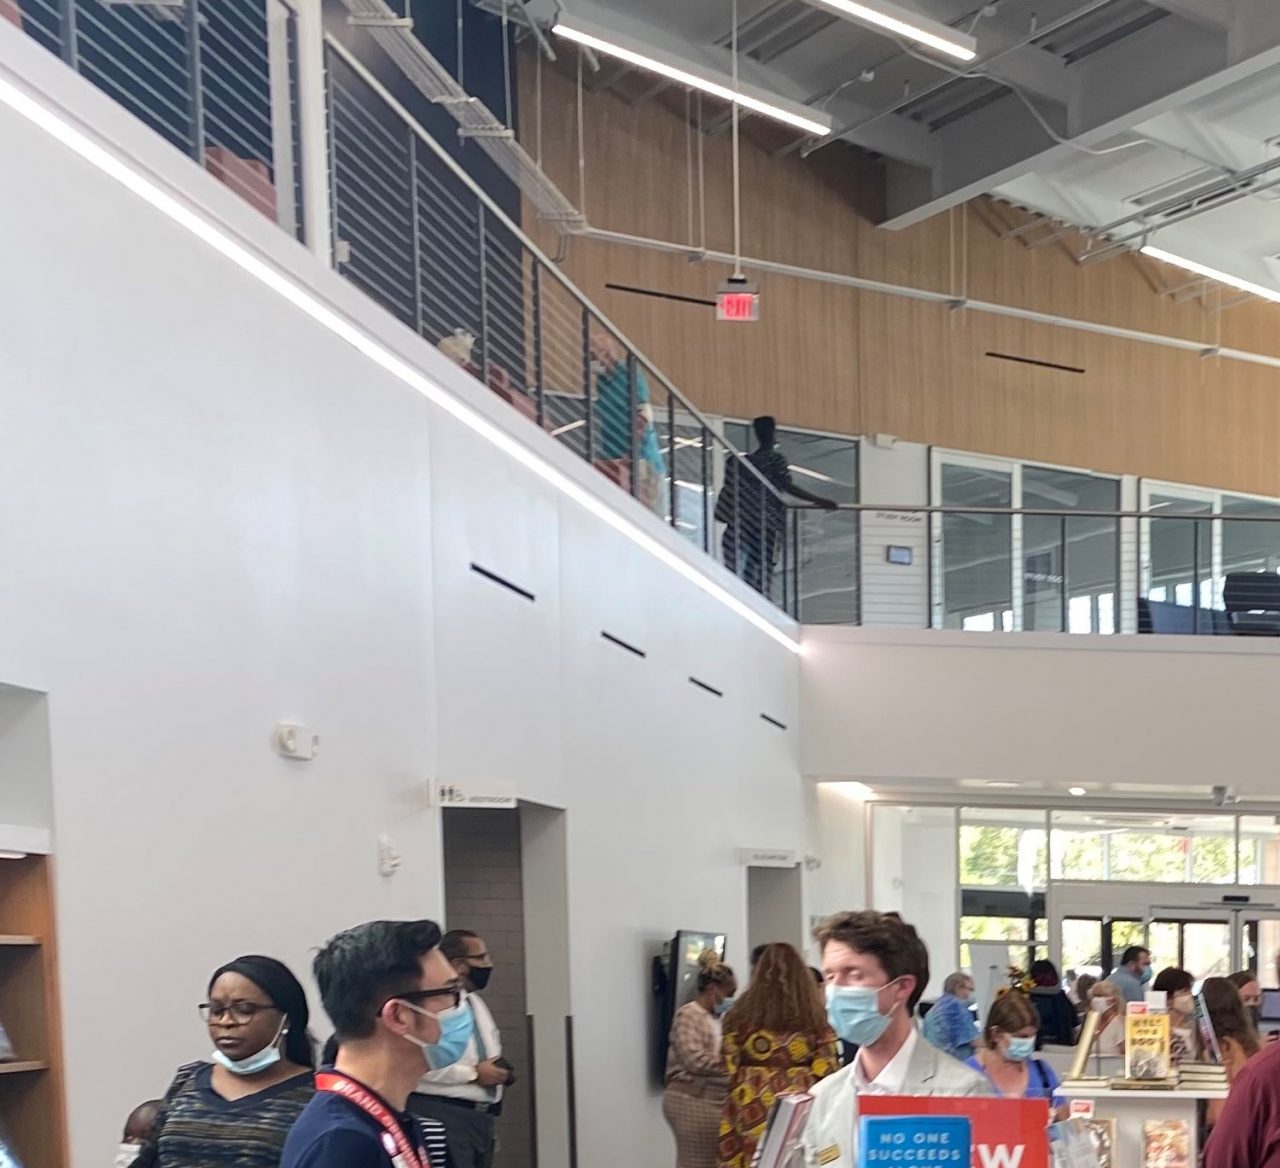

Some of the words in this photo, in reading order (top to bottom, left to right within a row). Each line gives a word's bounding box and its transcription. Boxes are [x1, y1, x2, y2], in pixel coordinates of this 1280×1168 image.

[332, 1080, 385, 1117] GRAND
[880, 1132, 905, 1144] NO
[913, 1132, 950, 1144] ONE
[867, 1149, 961, 1161] SUCCEEDS
